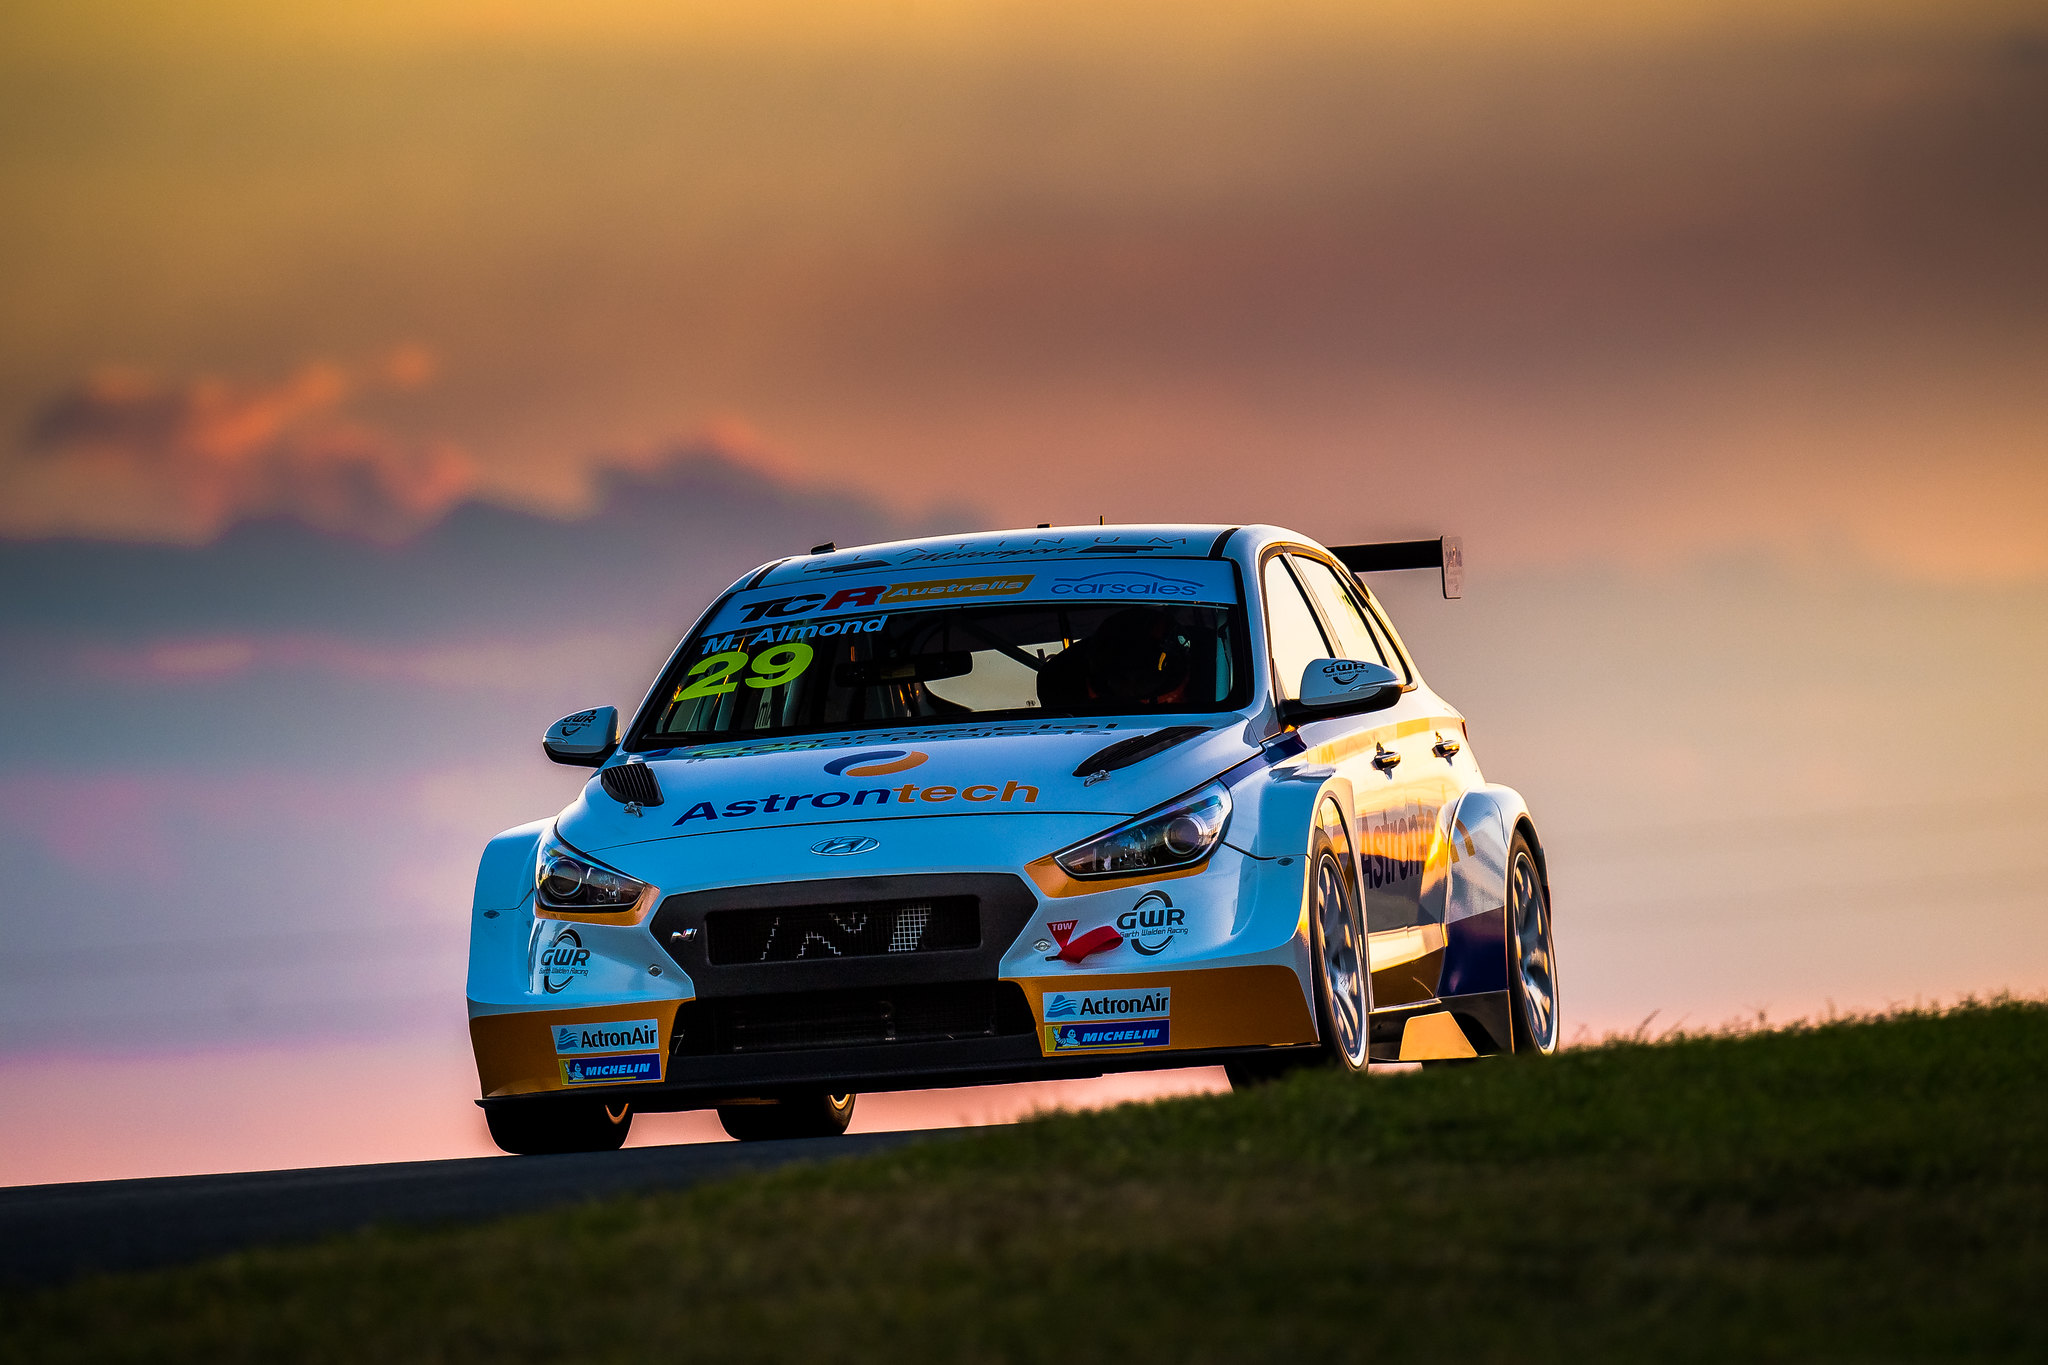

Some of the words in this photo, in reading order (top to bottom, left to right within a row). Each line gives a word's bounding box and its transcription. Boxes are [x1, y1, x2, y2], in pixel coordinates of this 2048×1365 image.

[1050, 580, 1199, 597] carsales
[739, 585, 888, 624] TCR
[888, 580, 1024, 599] Australia
[701, 633, 739, 655] M.
[749, 615, 888, 646] Almond
[673, 642, 814, 703] 29
[1322, 663, 1367, 673] GWR
[672, 780, 1040, 827] Astrontech
[1051, 922, 1073, 932] TOW
[1116, 908, 1186, 930] GWR
[1167, 926, 1189, 935] Racing
[540, 948, 591, 967] GWR
[1080, 993, 1169, 1016] ActronAir
[580, 1025, 657, 1049] ActronAir
[1082, 1028, 1160, 1043] MICHELIN
[585, 1062, 651, 1077] MICHELIN
